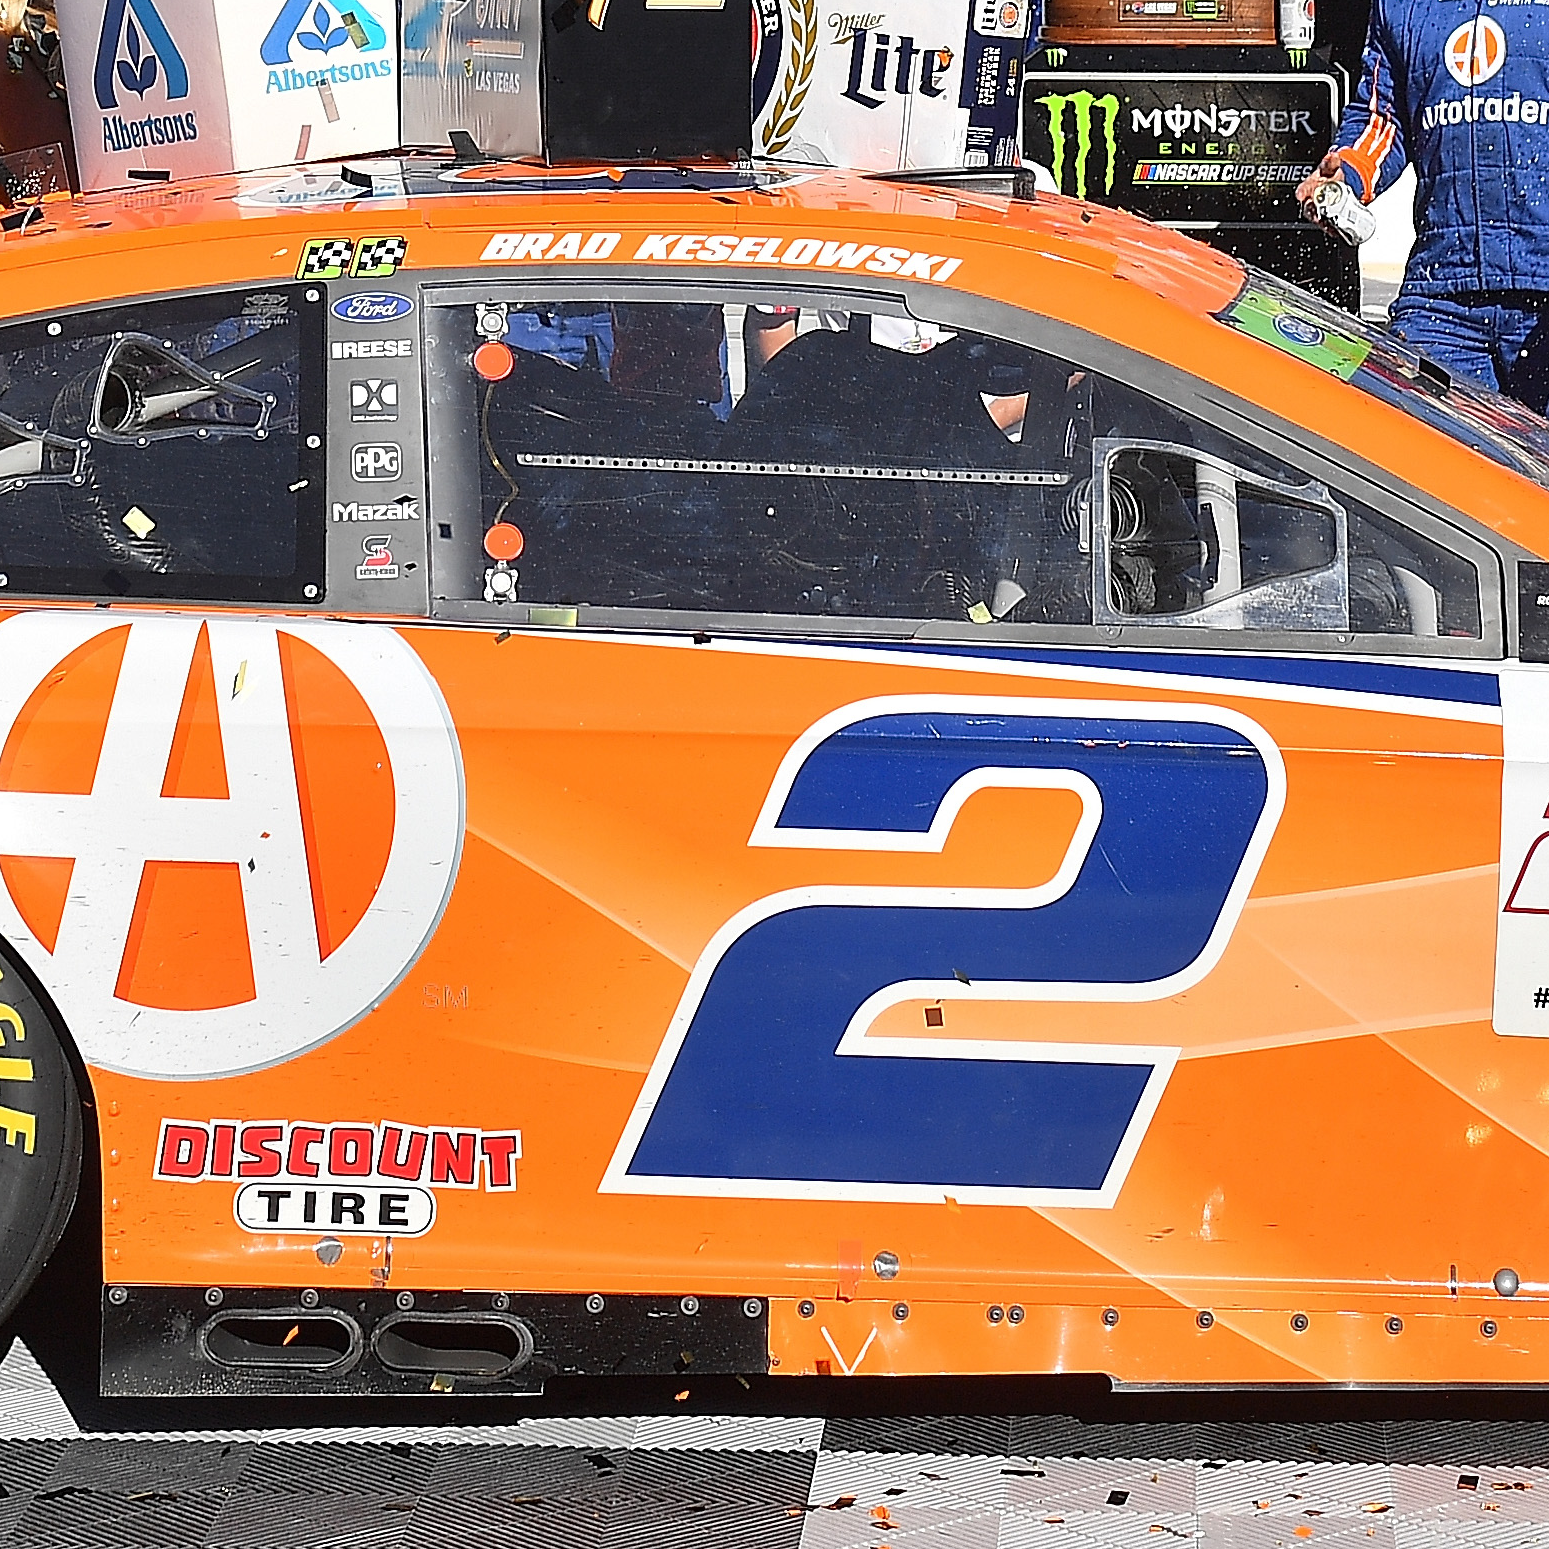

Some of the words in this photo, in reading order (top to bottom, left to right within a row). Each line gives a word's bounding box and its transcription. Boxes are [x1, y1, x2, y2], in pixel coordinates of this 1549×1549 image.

[829, 13, 887, 45] Miller
[267, 58, 392, 94] Albertsons
[475, 70, 492, 92] LAS
[493, 72, 521, 94] VEGAS
[841, 27, 949, 110] Lite
[103, 112, 198, 153] Albertsons
[1131, 103, 1317, 139] MONSTER
[1156, 163, 1220, 182] NASCAR
[1222, 163, 1255, 182] CUP
[1256, 163, 1313, 182] SERIES
[478, 231, 623, 263] BRAD
[634, 233, 964, 282] KESELOWSKI
[346, 295, 397, 318] Ford
[355, 446, 399, 477] PPG
[332, 502, 420, 522] Mazak
[597, 693, 1288, 1209] 2
[159, 1122, 519, 1188] DISCOUNT
[250, 1189, 413, 1227] TIRE
